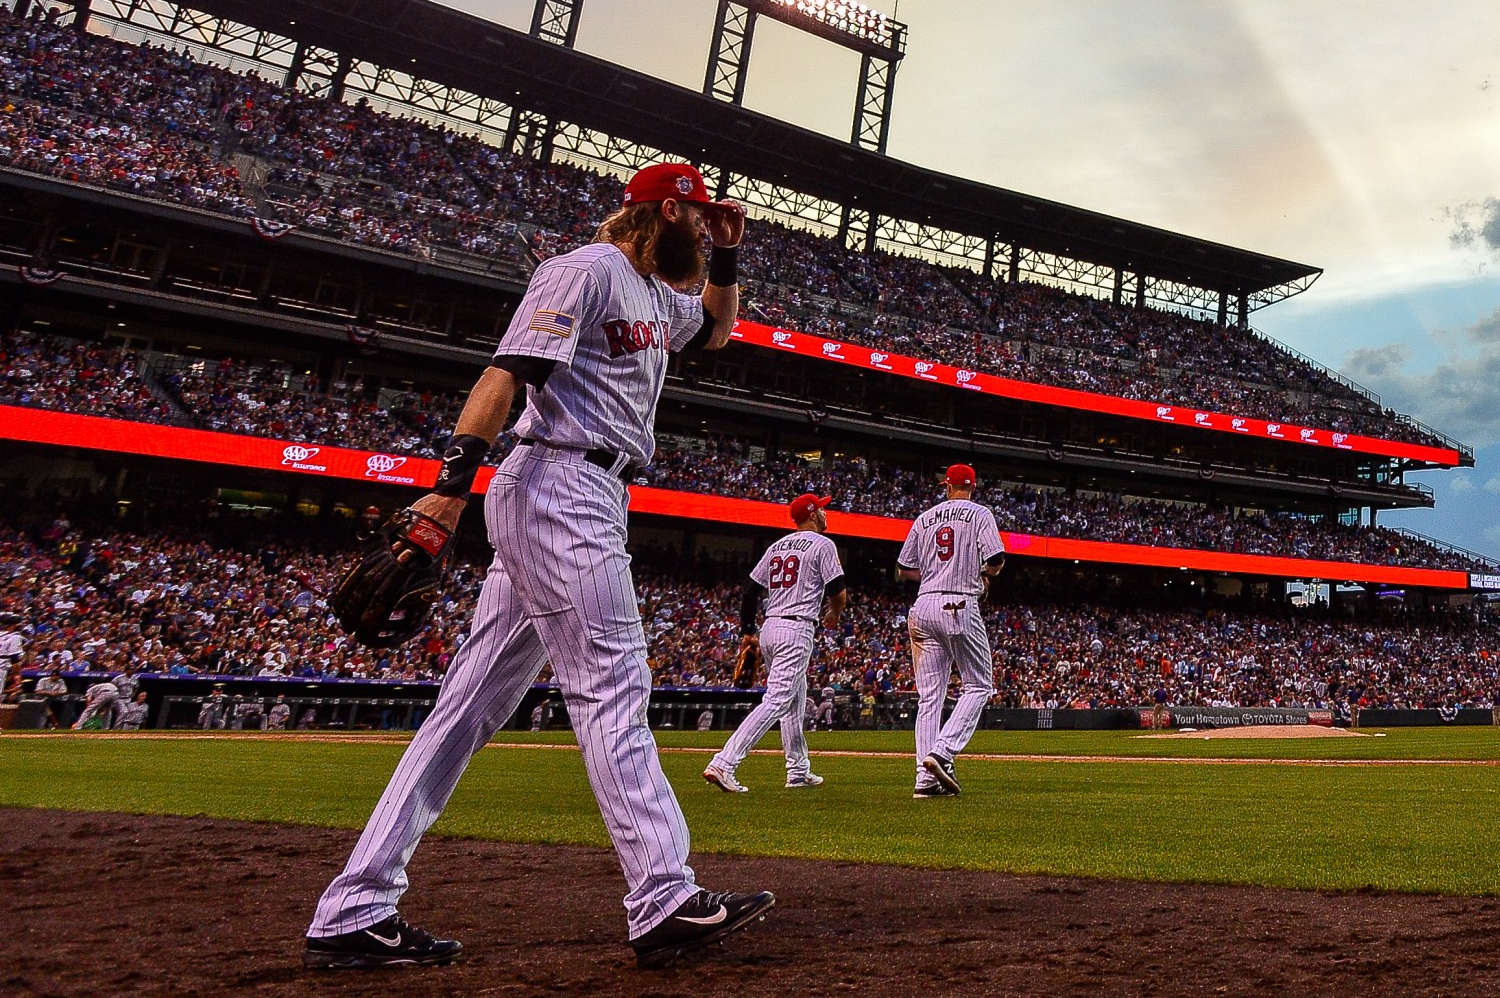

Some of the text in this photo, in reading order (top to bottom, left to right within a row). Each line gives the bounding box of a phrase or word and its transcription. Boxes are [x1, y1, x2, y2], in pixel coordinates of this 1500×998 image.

[292, 462, 327, 472] Insurance
[376, 473, 414, 484] Insurance
[936, 525, 955, 562] 9
[770, 555, 800, 589] 28
[1174, 713, 1195, 724] Your
[1197, 714, 1240, 725] Hometown
[1254, 714, 1284, 724] TOYOTA
